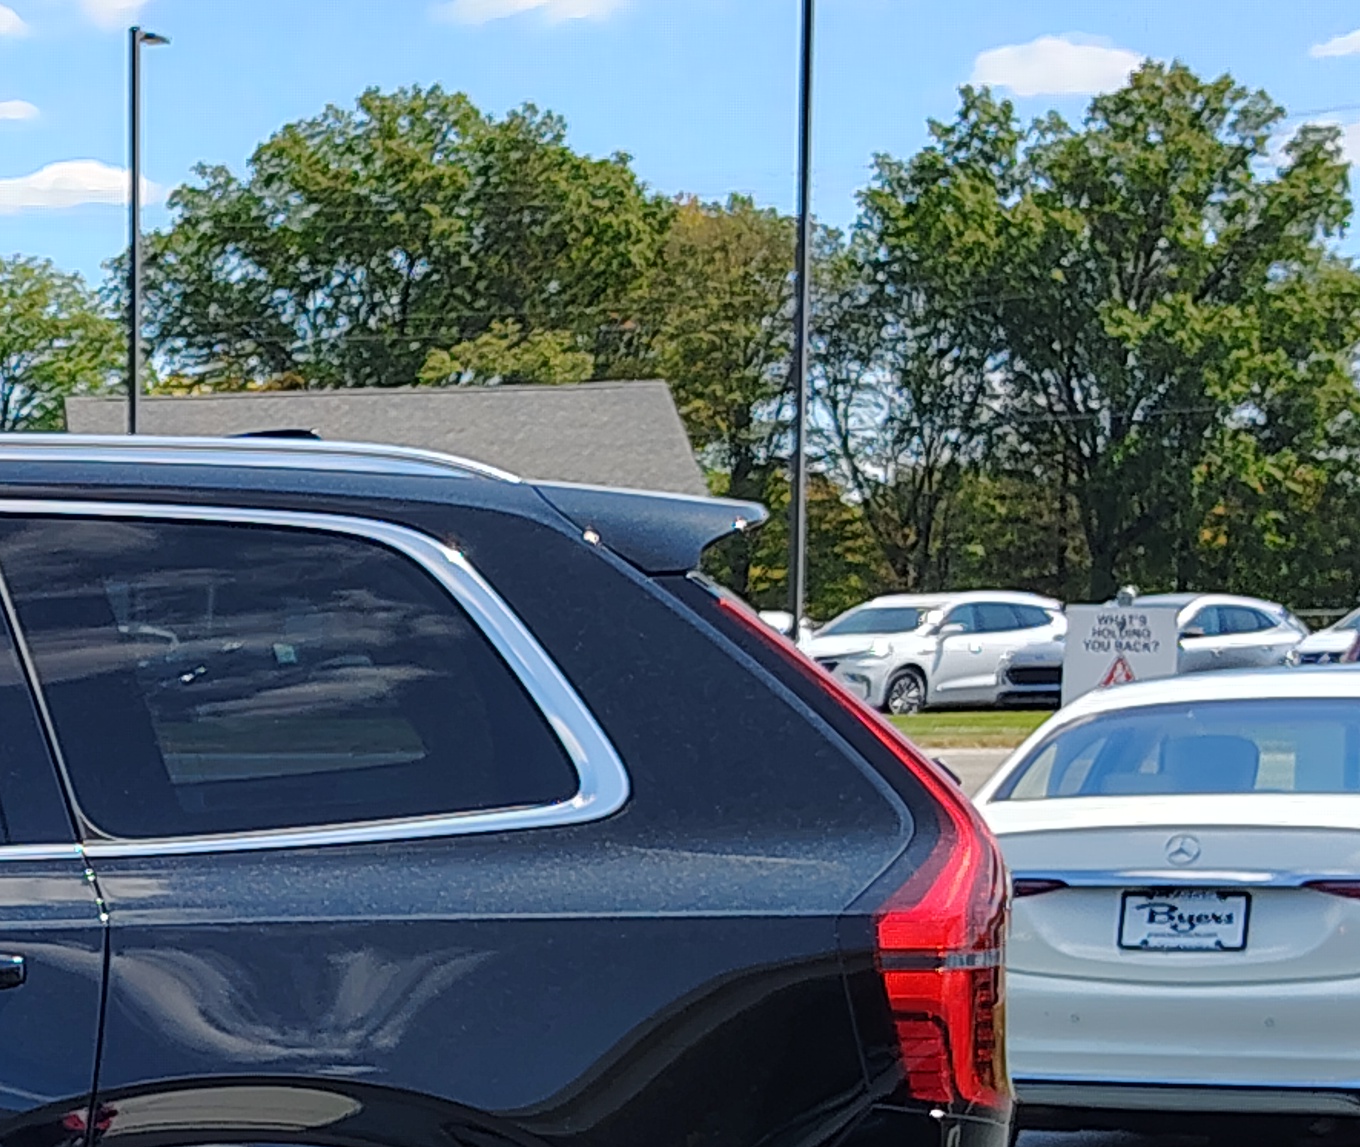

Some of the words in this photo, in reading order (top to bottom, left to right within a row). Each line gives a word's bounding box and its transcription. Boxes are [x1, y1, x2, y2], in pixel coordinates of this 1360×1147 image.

[1083, 640, 1111, 652] YOU
[1114, 640, 1160, 653] BACK?
[1135, 902, 1234, 933] Byers
